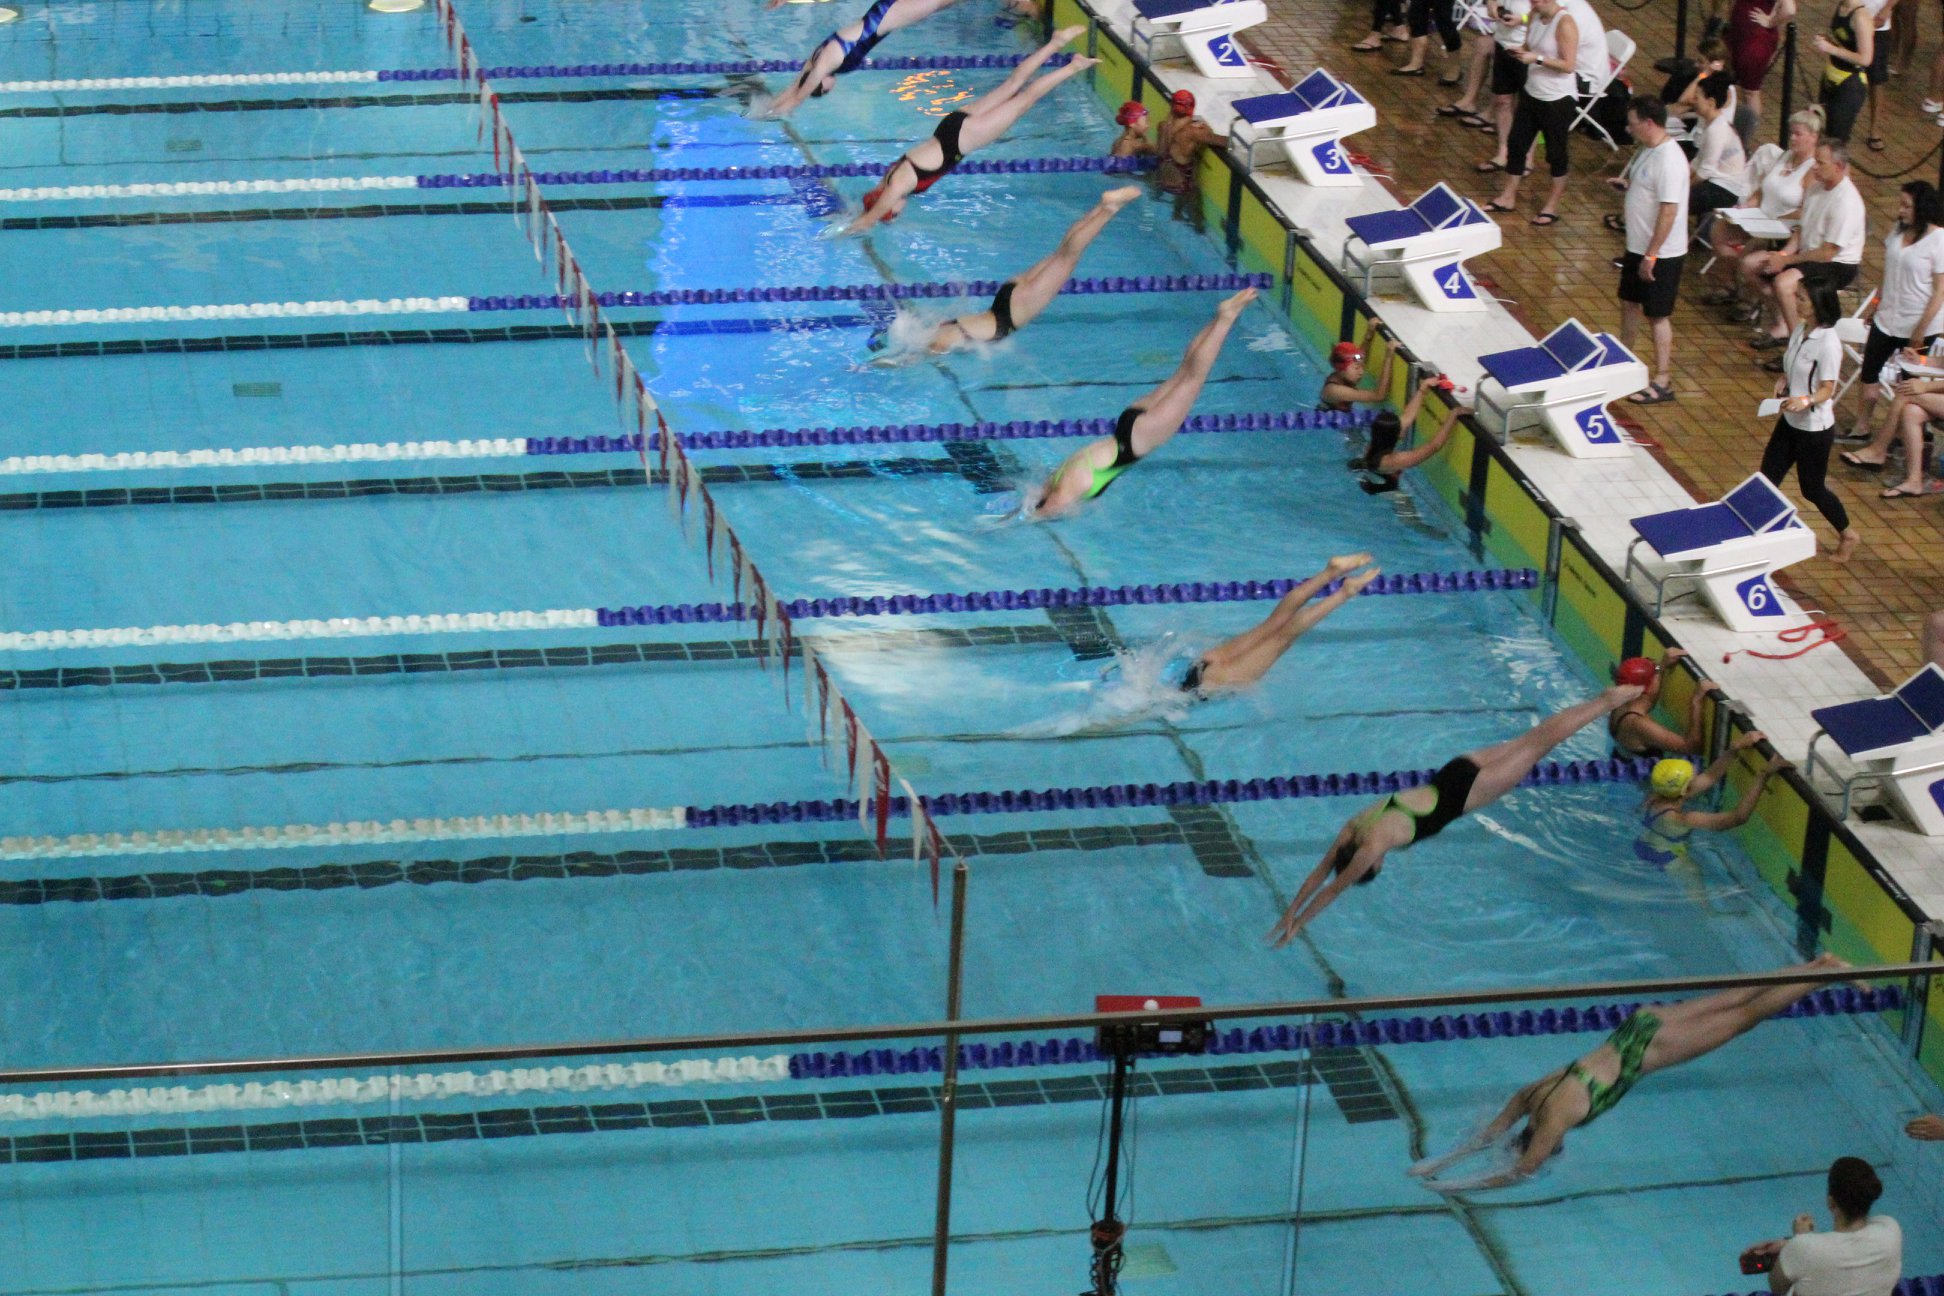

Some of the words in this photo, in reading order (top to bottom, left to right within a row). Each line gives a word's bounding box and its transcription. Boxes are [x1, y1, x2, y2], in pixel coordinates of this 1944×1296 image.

[1218, 42, 1233, 63] 2
[1325, 148, 1341, 170] 3
[1443, 271, 1461, 294] 4
[1586, 414, 1604, 439] 5
[1747, 583, 1767, 610] 6
